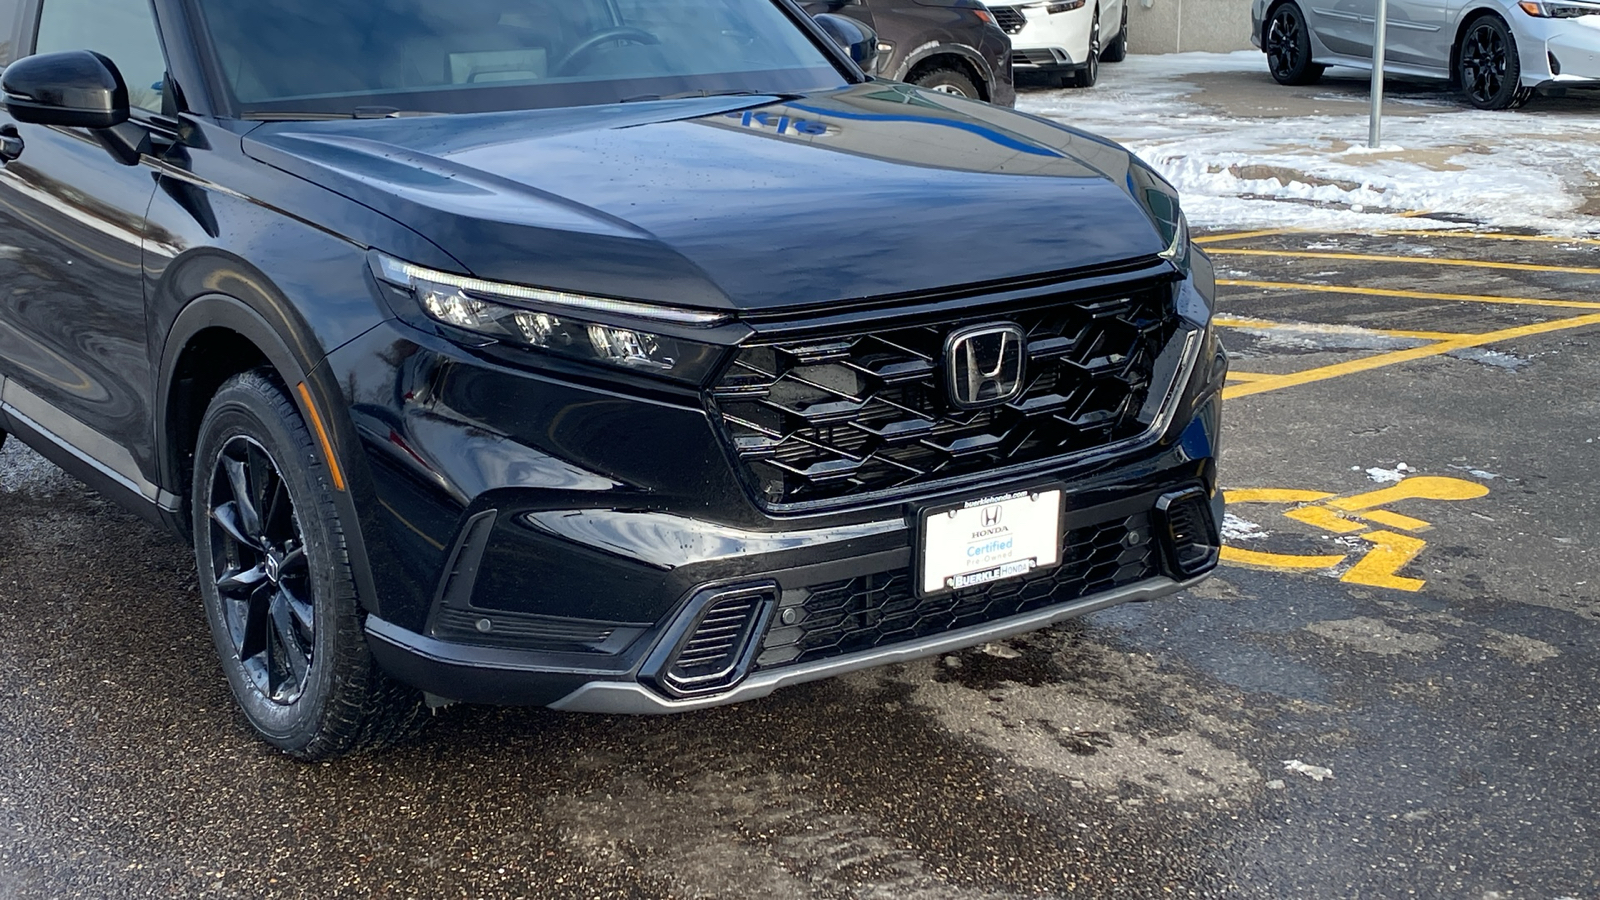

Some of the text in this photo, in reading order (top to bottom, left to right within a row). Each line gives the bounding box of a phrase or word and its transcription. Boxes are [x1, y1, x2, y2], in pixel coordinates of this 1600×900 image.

[964, 490, 1028, 509] buerklehonda.com
[971, 525, 1009, 539] HONDA
[966, 537, 1013, 557] Certified
